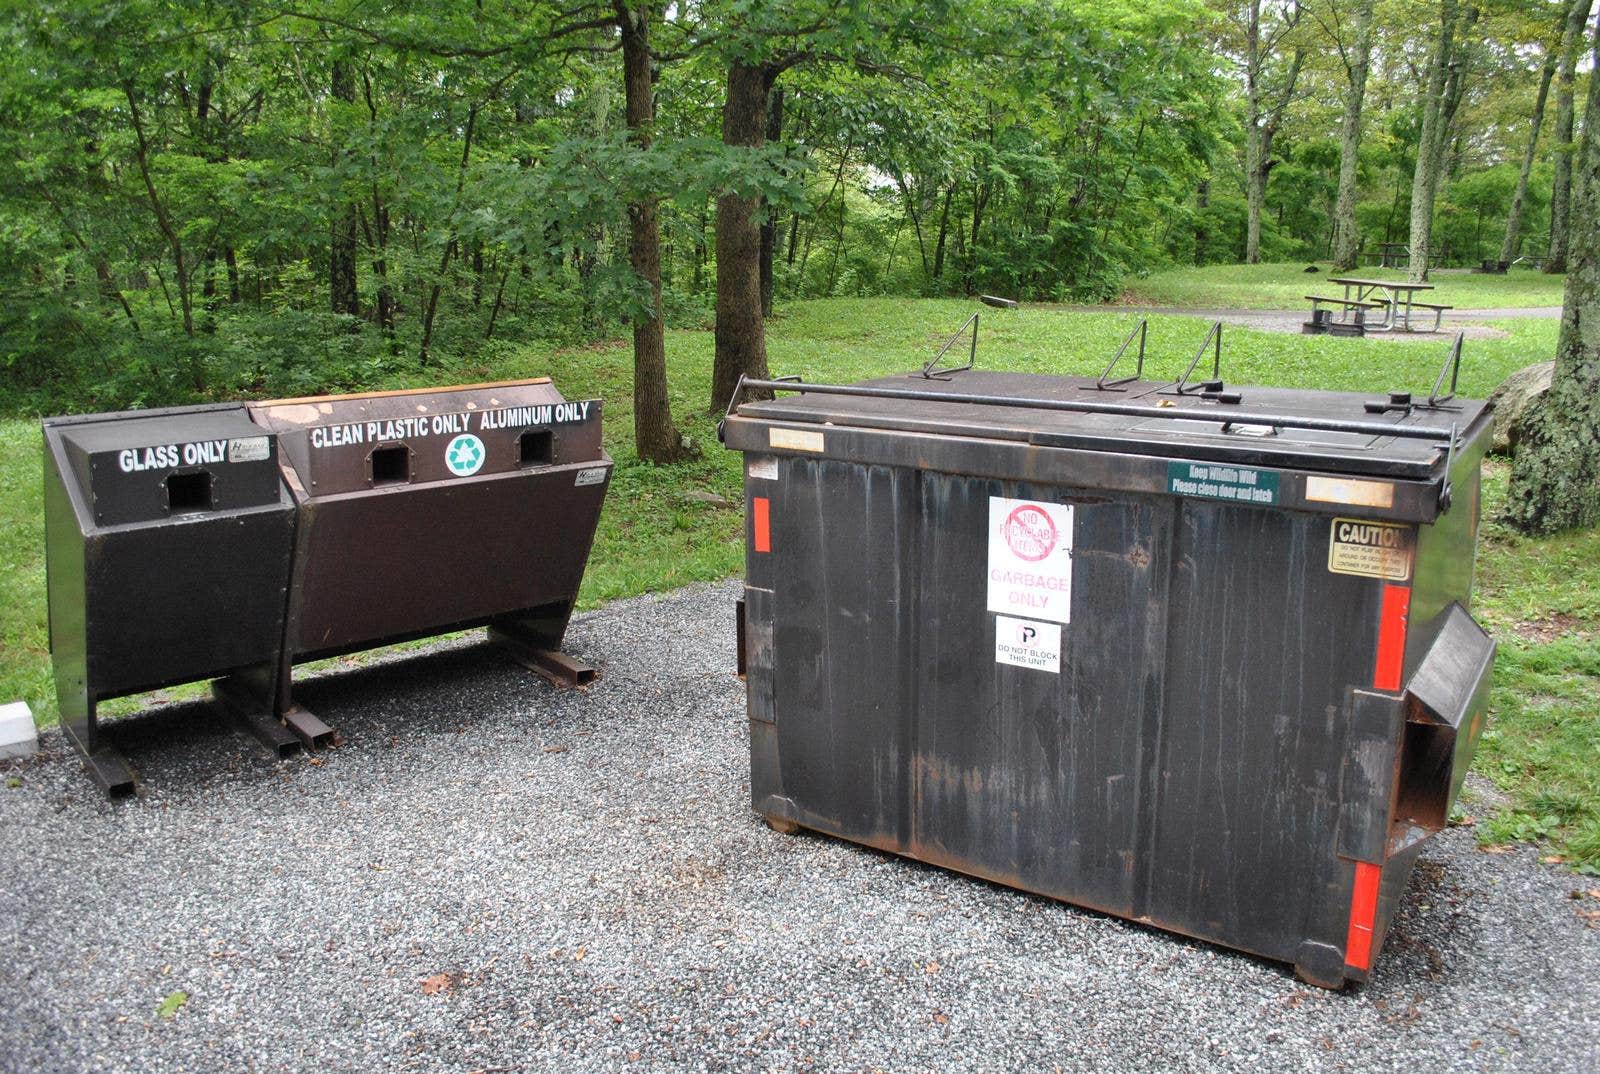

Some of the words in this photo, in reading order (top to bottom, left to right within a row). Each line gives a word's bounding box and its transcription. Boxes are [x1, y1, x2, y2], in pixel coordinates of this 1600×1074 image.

[480, 406, 552, 430] ALUMINUM
[555, 402, 590, 423] ONLY
[311, 424, 363, 448] CLEAN
[367, 417, 428, 441] PLASTIC
[432, 413, 471, 435] ONLY
[120, 446, 179, 473] GLASS
[184, 439, 228, 465] ONLY
[1189, 464, 1208, 480] Keep
[1209, 466, 1238, 483] Wildlife
[1239, 469, 1257, 485] Wild
[1172, 478, 1197, 494] Please
[1197, 481, 1218, 496] close
[1219, 484, 1237, 498] door
[1237, 486, 1252, 500] and
[1252, 487, 1273, 503] latch
[1023, 512, 1037, 524] NO
[991, 568, 1068, 591] GARBAGE
[1008, 591, 1049, 609] ONLY
[998, 644, 1010, 652] DO
[1011, 646, 1028, 655] NOT
[1030, 649, 1057, 660] BLOCK
[1010, 654, 1027, 663] THIS
[1028, 657, 1047, 666] UNIT
